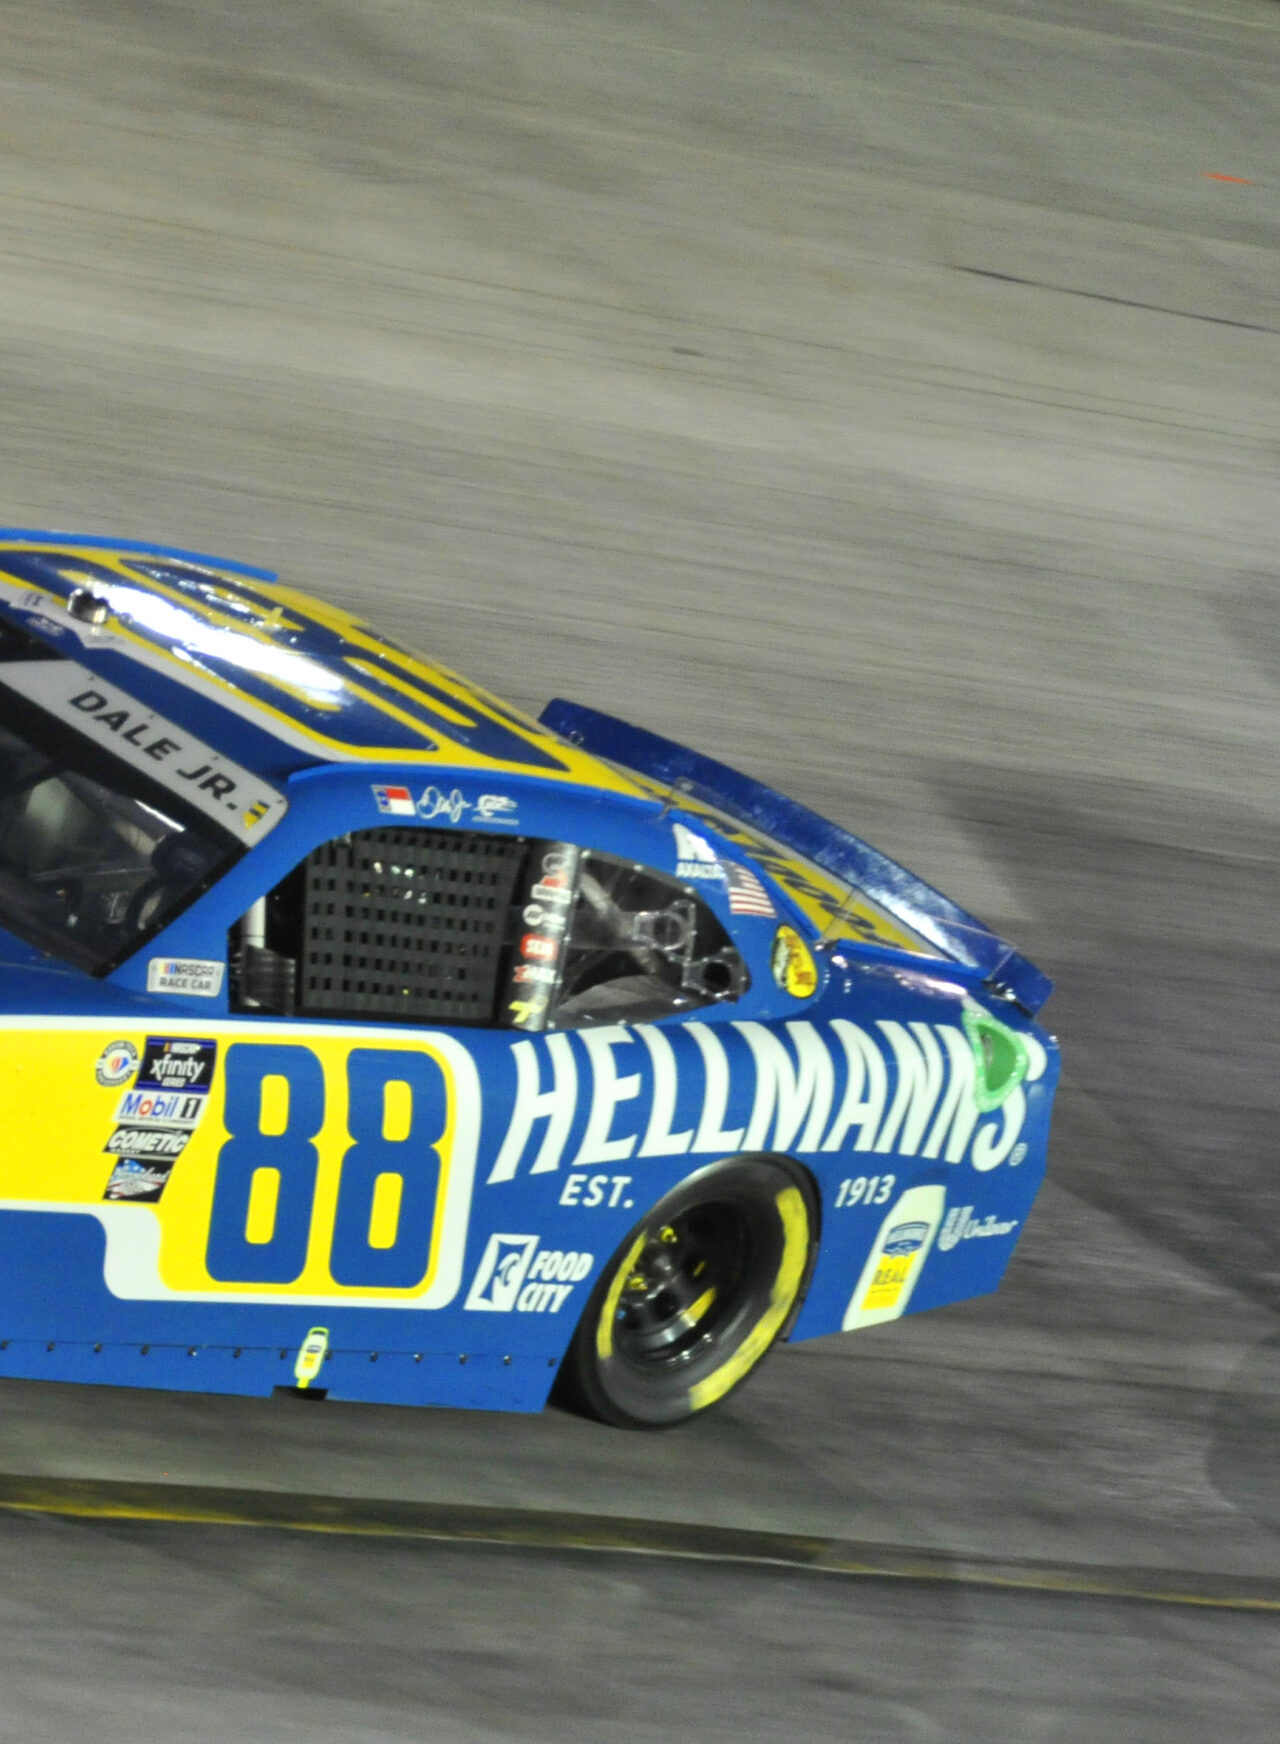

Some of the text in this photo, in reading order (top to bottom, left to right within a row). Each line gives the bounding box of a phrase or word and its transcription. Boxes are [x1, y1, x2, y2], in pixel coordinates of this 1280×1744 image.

[70, 690, 238, 811] DALE JR.
[160, 977, 212, 990] RACE CAR
[150, 1053, 206, 1084] xfinity
[120, 1093, 180, 1118] Mobil
[108, 1129, 190, 1153] COMETIC
[205, 1042, 449, 1289] 88
[559, 1174, 897, 1209] EST. 1913
[527, 1250, 595, 1282] FOOD
[871, 1266, 908, 1286] REAL
[516, 1281, 575, 1313] CITY
